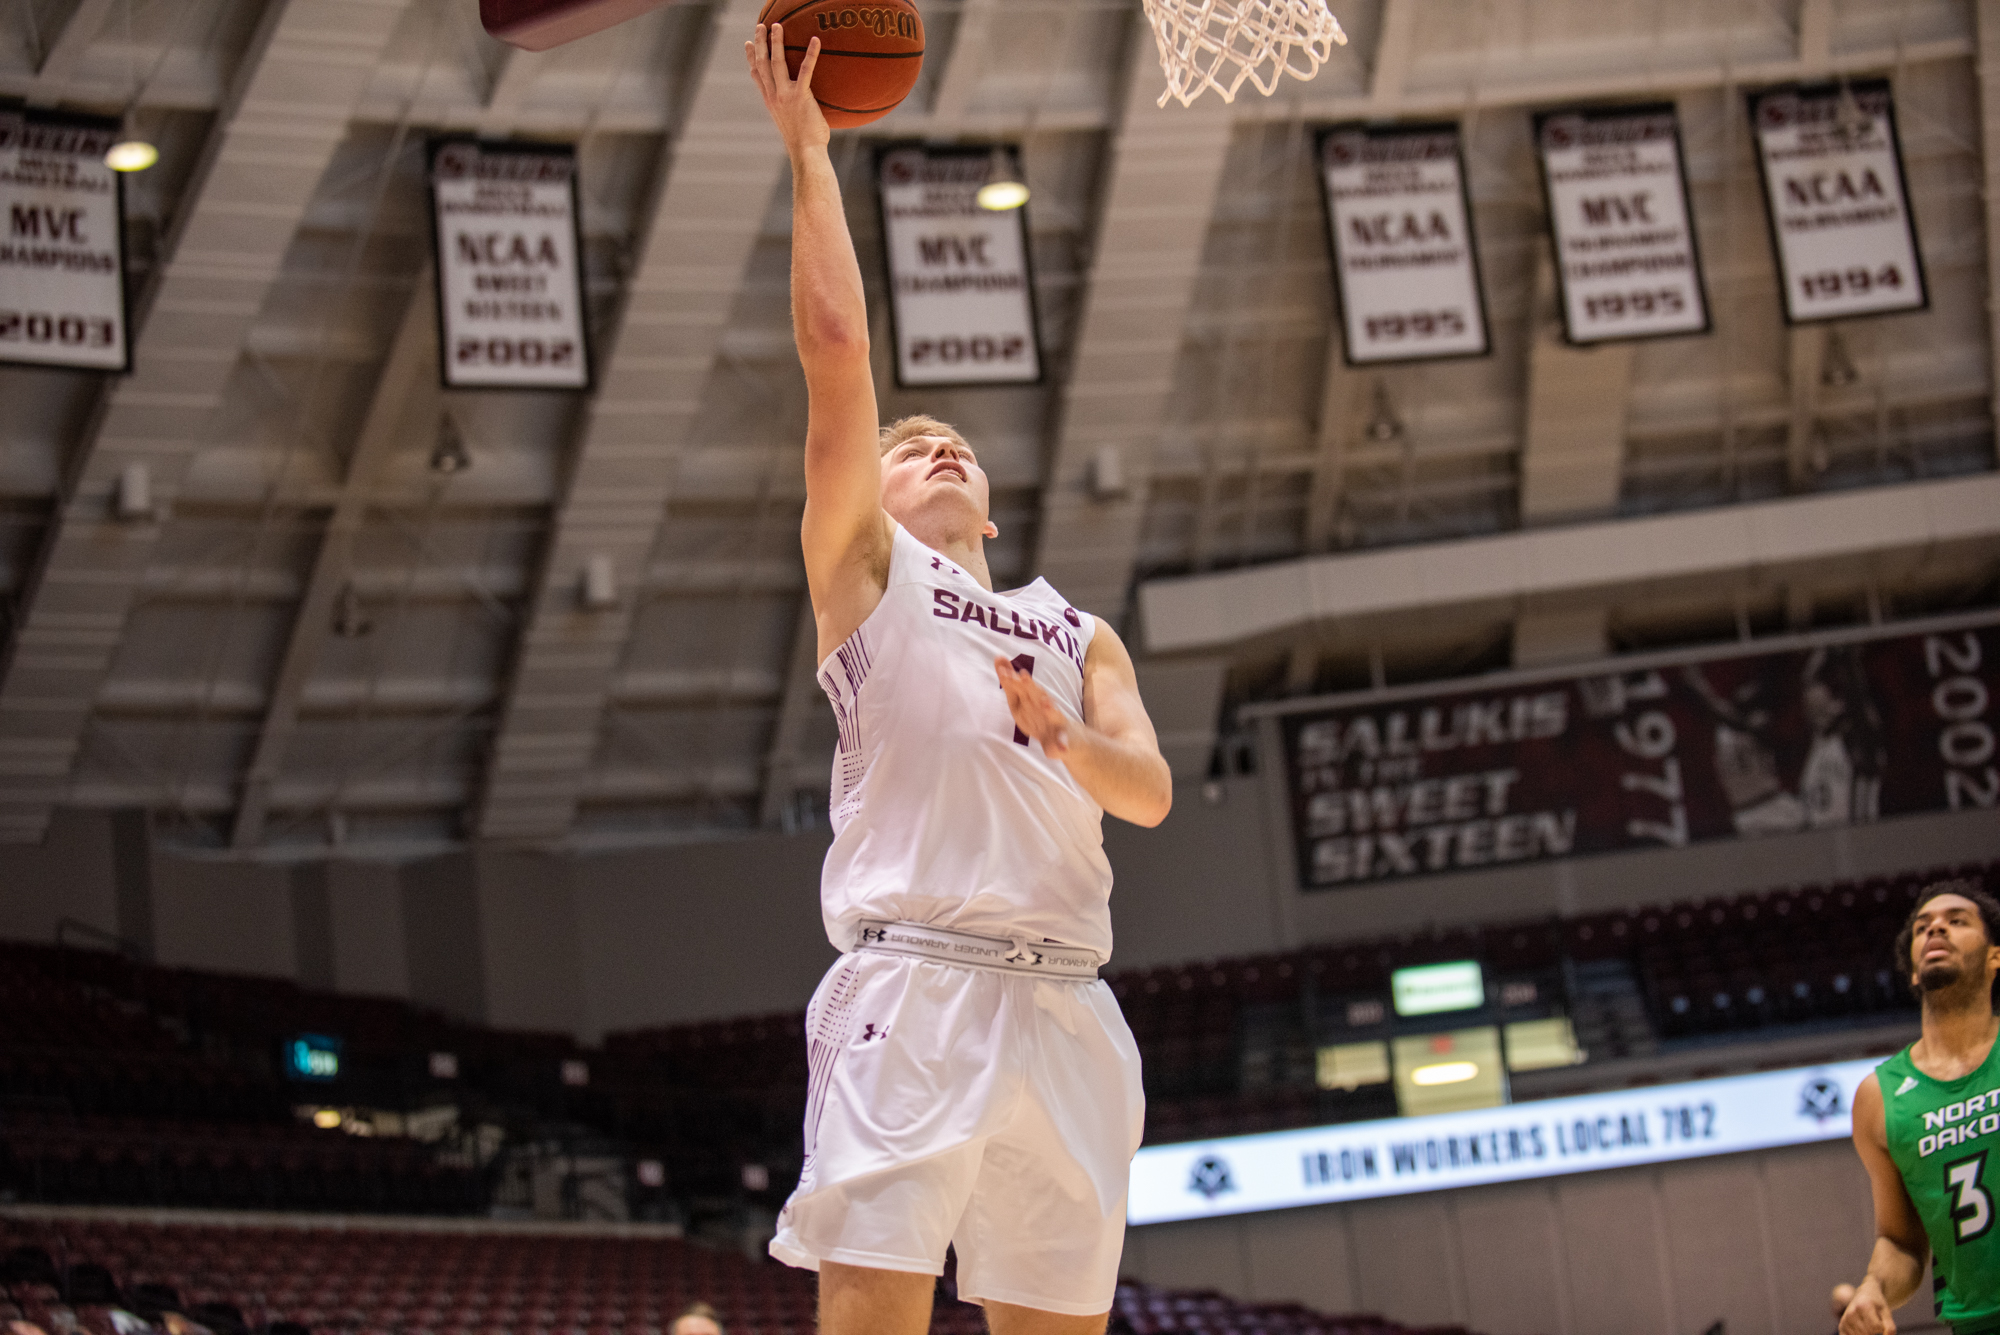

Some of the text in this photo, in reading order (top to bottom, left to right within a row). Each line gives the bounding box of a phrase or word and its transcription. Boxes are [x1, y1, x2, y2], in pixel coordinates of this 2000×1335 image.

[815, 7, 918, 42] Wilson
[1786, 166, 1883, 205] NCAA
[11, 203, 88, 245] MVC
[1581, 192, 1655, 225] MVC
[1350, 212, 1450, 246] NCAA
[457, 230, 559, 268] NCAA
[917, 234, 991, 269] MVC
[1801, 264, 1902, 299] 1994
[1584, 286, 1683, 320] 1995
[0, 312, 115, 347] 2003
[1364, 310, 1464, 341] 1995
[457, 338, 574, 368] 2002
[910, 336, 1025, 367] 2002
[933, 588, 1084, 680] SALUKIS
[1298, 692, 1569, 763] SALUKIS
[1925, 632, 2000, 812] 2002
[1613, 668, 1690, 847] 1977
[1307, 768, 1521, 837] SWEET
[1310, 808, 1577, 885] SIXTEEN
[889, 932, 1000, 959] UNDER ARMOUR
[1047, 956, 1089, 970] ARMOUR
[1302, 1101, 1719, 1188] IRON WORKERS LOCAL 782
[1943, 1148, 1996, 1247] 3
